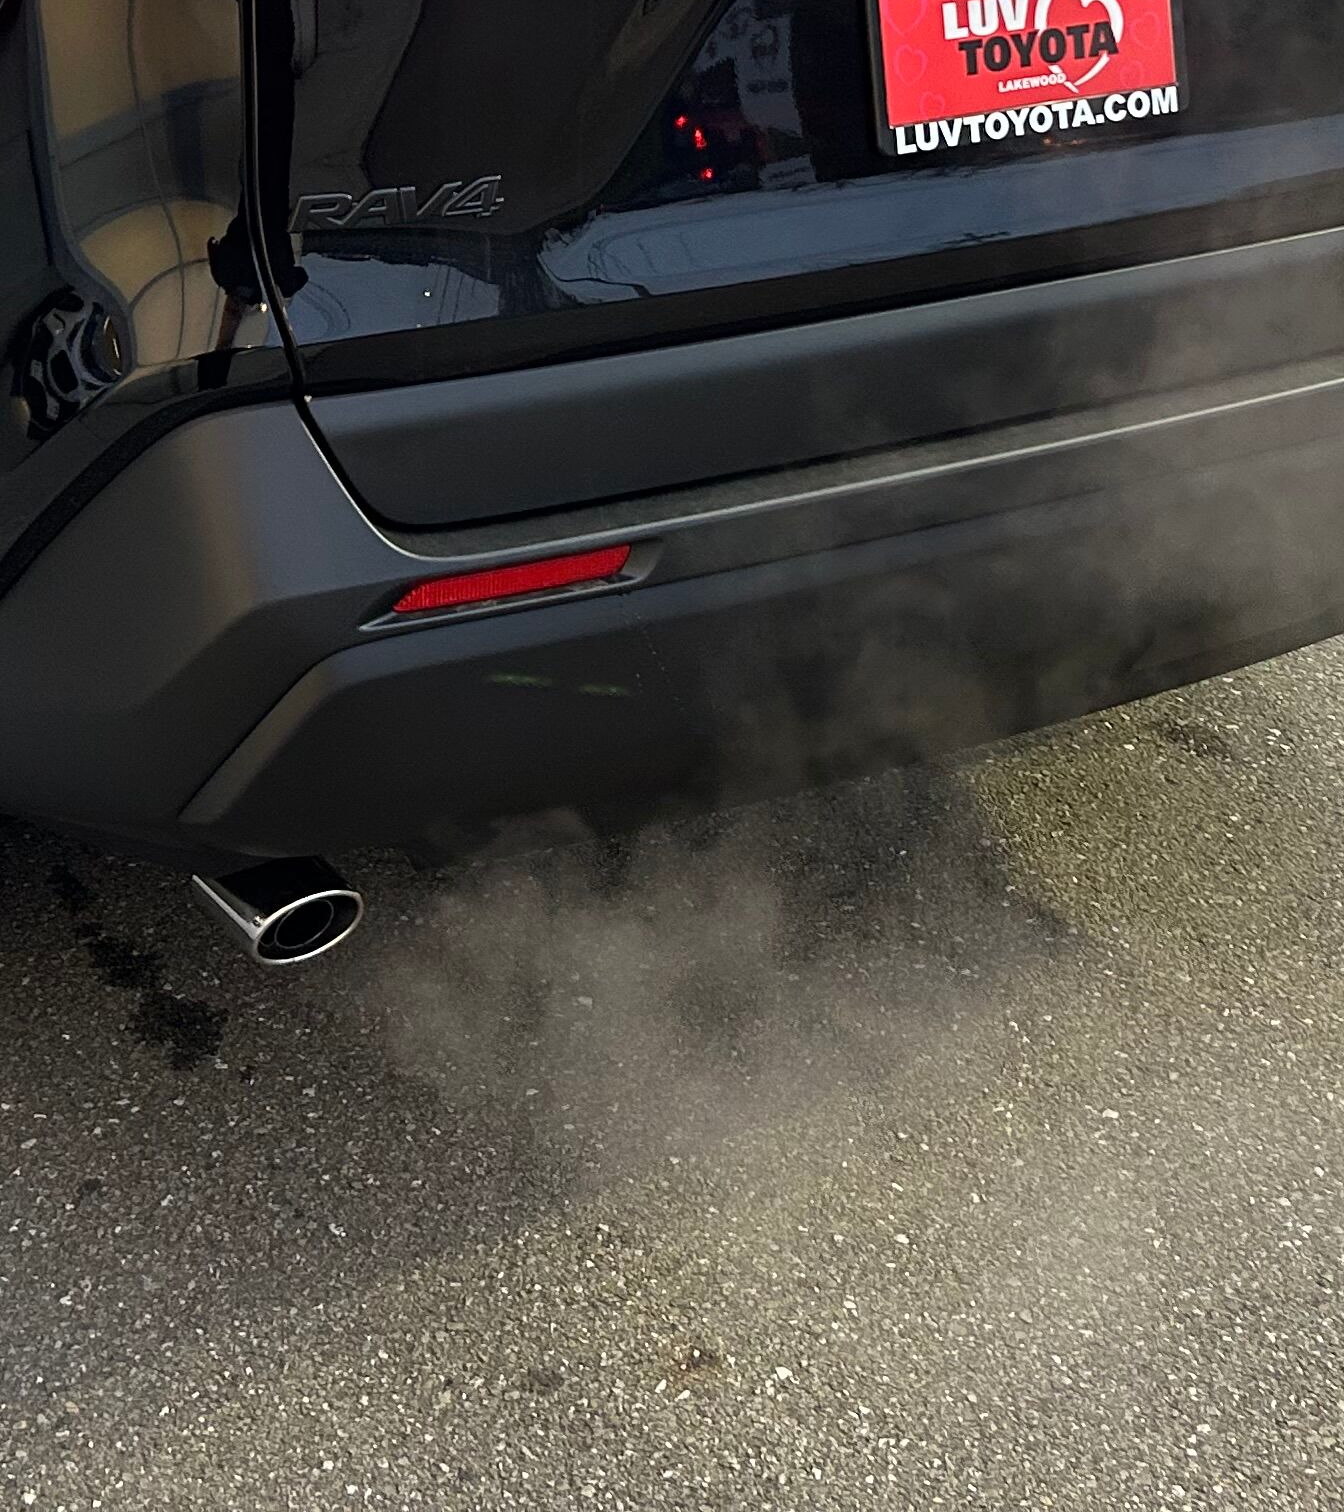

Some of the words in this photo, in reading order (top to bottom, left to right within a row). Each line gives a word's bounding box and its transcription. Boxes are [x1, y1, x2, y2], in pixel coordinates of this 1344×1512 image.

[958, 21, 1119, 76] TOYOTA
[998, 73, 1067, 94] LAKEWOOD
[893, 86, 1179, 155] LUVTOYOTA.COM
[287, 175, 504, 232] RAV4
